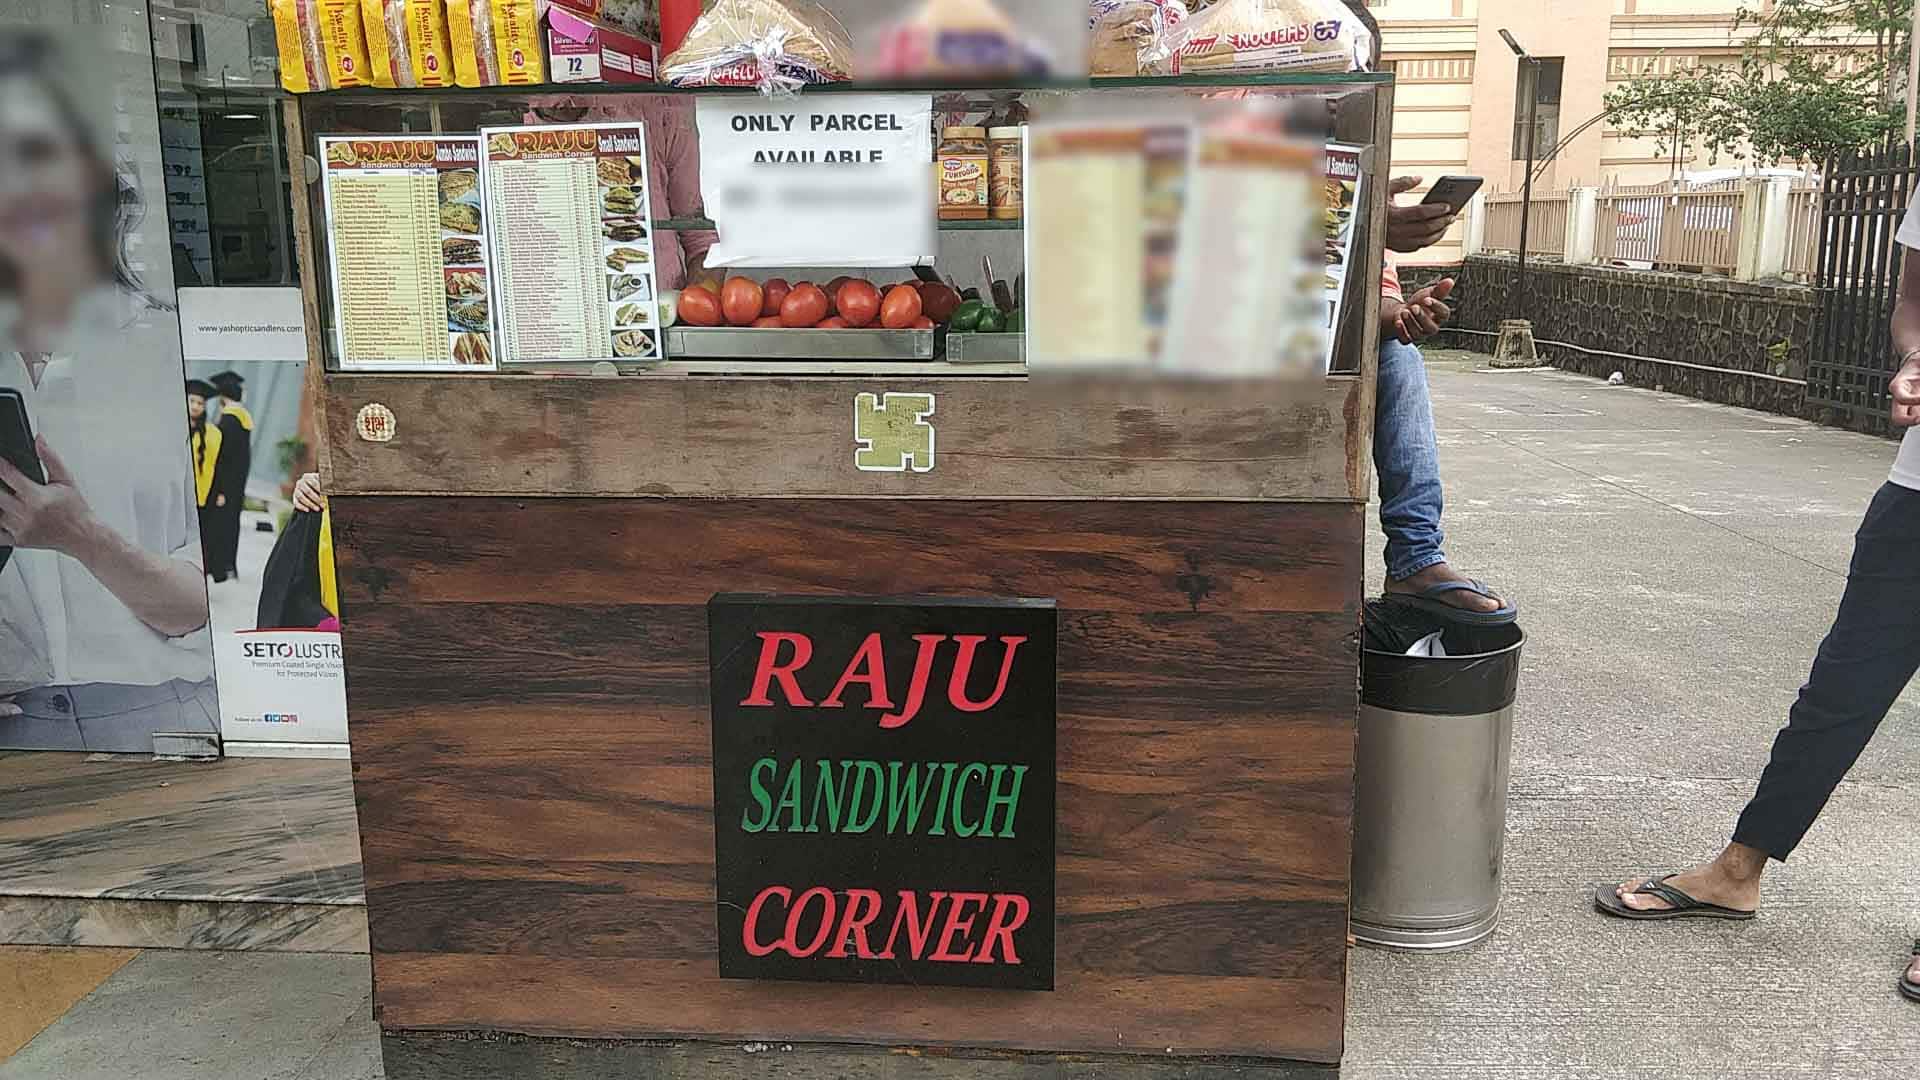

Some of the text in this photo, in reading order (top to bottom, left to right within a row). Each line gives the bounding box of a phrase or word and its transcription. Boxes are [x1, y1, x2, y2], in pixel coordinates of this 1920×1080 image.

[334, 9, 348, 50] Kwality
[420, 7, 434, 49] Kwality
[567, 57, 583, 72] 72
[731, 114, 903, 132] ONLY PARCEL
[354, 141, 435, 162] RAJU
[514, 130, 597, 153] RAJU
[361, 161, 433, 169] Sandwich Corner
[522, 152, 563, 160] Sandwich
[1331, 156, 1358, 177] Sandwich
[198, 324, 303, 335] www.yashopticsandlens.com
[243, 642, 343, 659] SETOLUSTR
[739, 631, 1028, 729] RAJU
[741, 757, 1030, 839] SANDWICH
[742, 886, 1030, 964] CORNER
